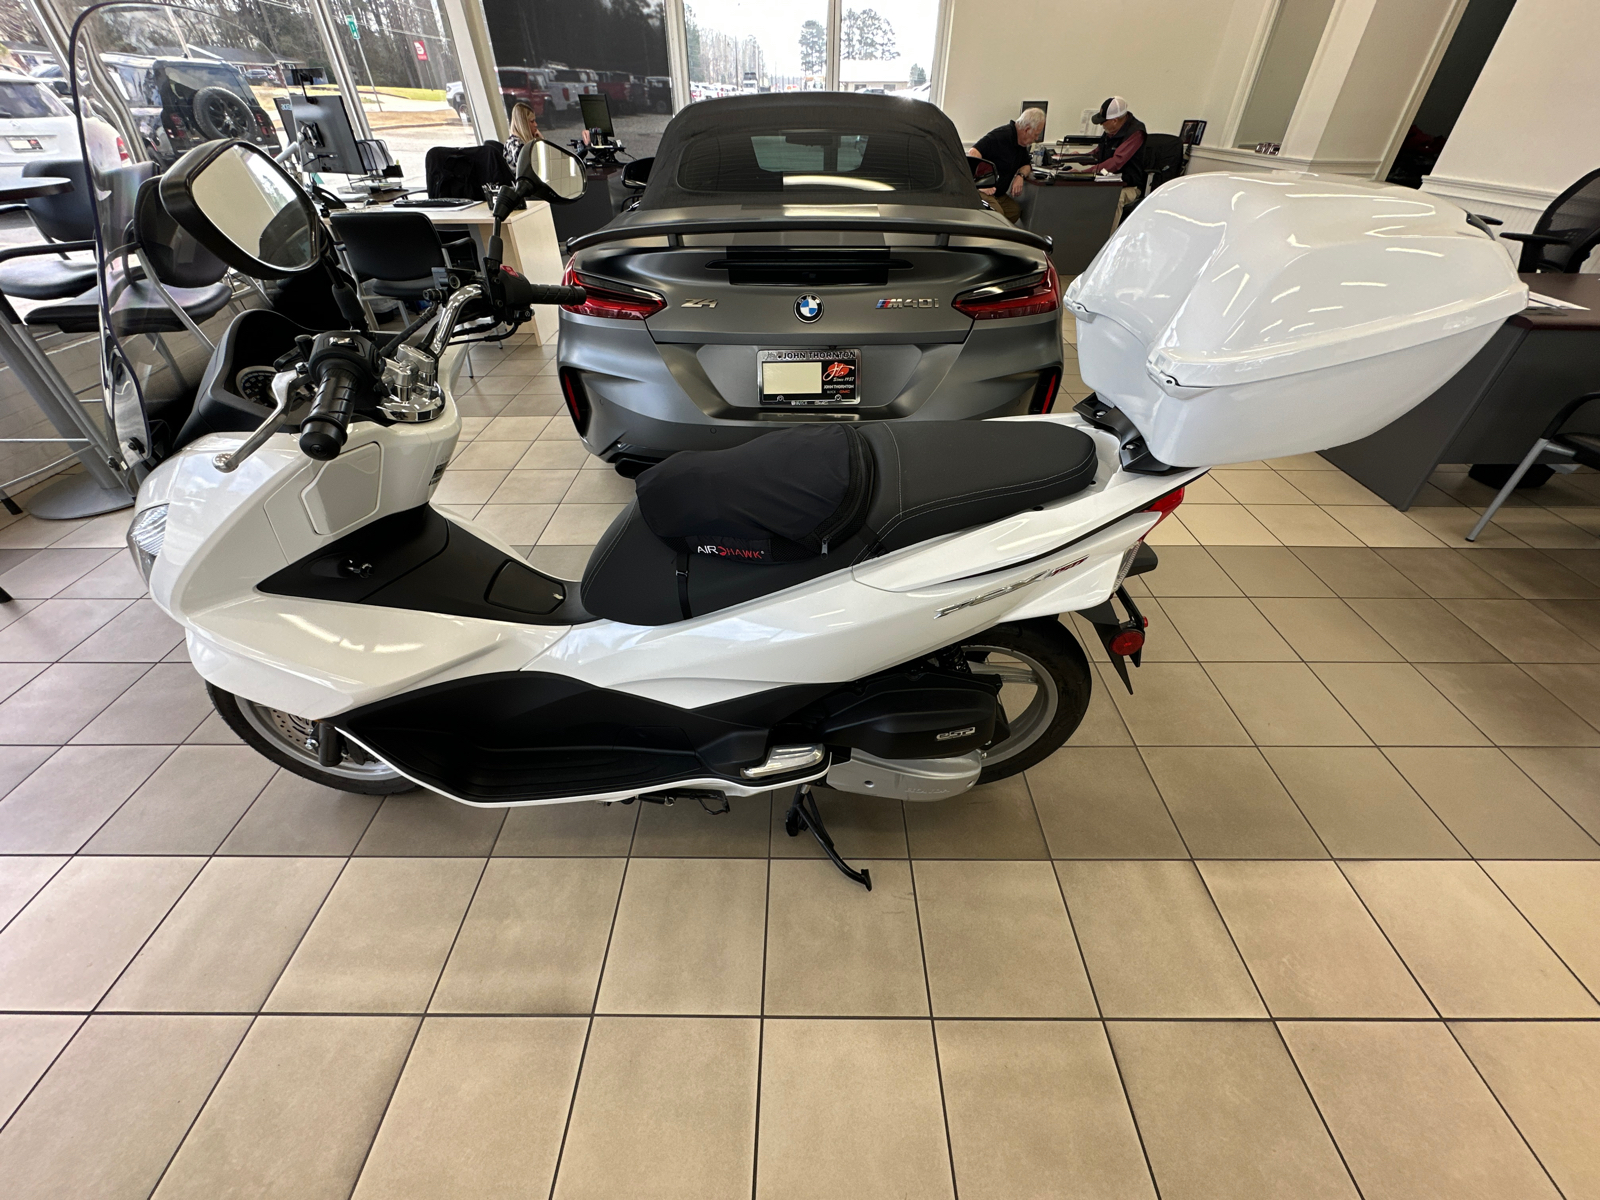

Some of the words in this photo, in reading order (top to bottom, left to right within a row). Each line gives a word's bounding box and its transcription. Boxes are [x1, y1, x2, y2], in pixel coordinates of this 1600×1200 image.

[681, 298, 718, 309] Z4
[876, 297, 940, 309] M40i
[809, 351, 856, 359] THORNTON
